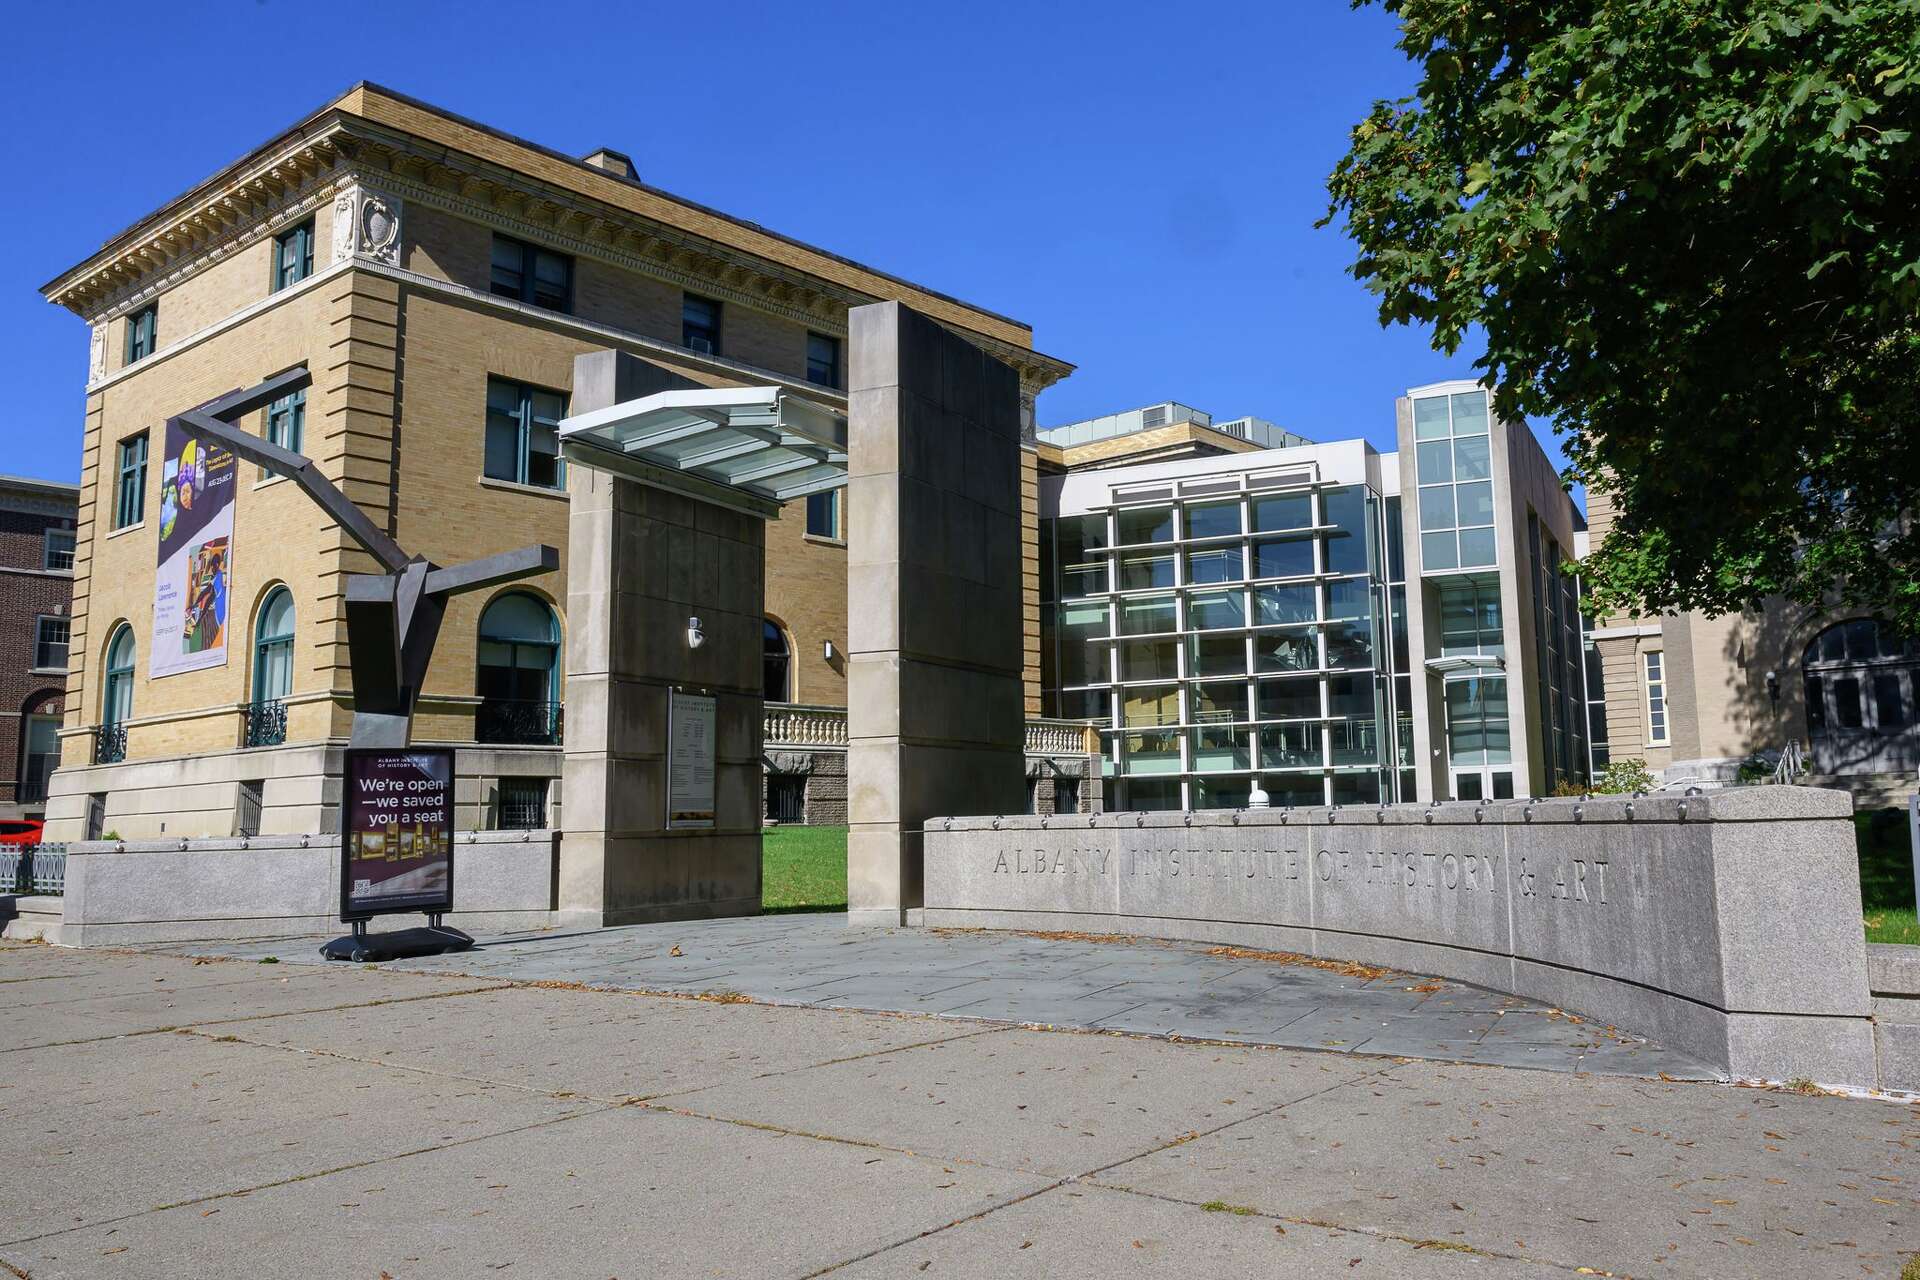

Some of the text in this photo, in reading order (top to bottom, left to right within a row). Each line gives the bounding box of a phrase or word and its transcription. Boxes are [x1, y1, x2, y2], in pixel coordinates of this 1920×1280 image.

[408, 780, 444, 792] open
[403, 793, 444, 807] saved
[369, 809, 444, 827] you a seat
[993, 849, 1609, 905] ALBANY INSTITUTE OF HISTORY & ART
